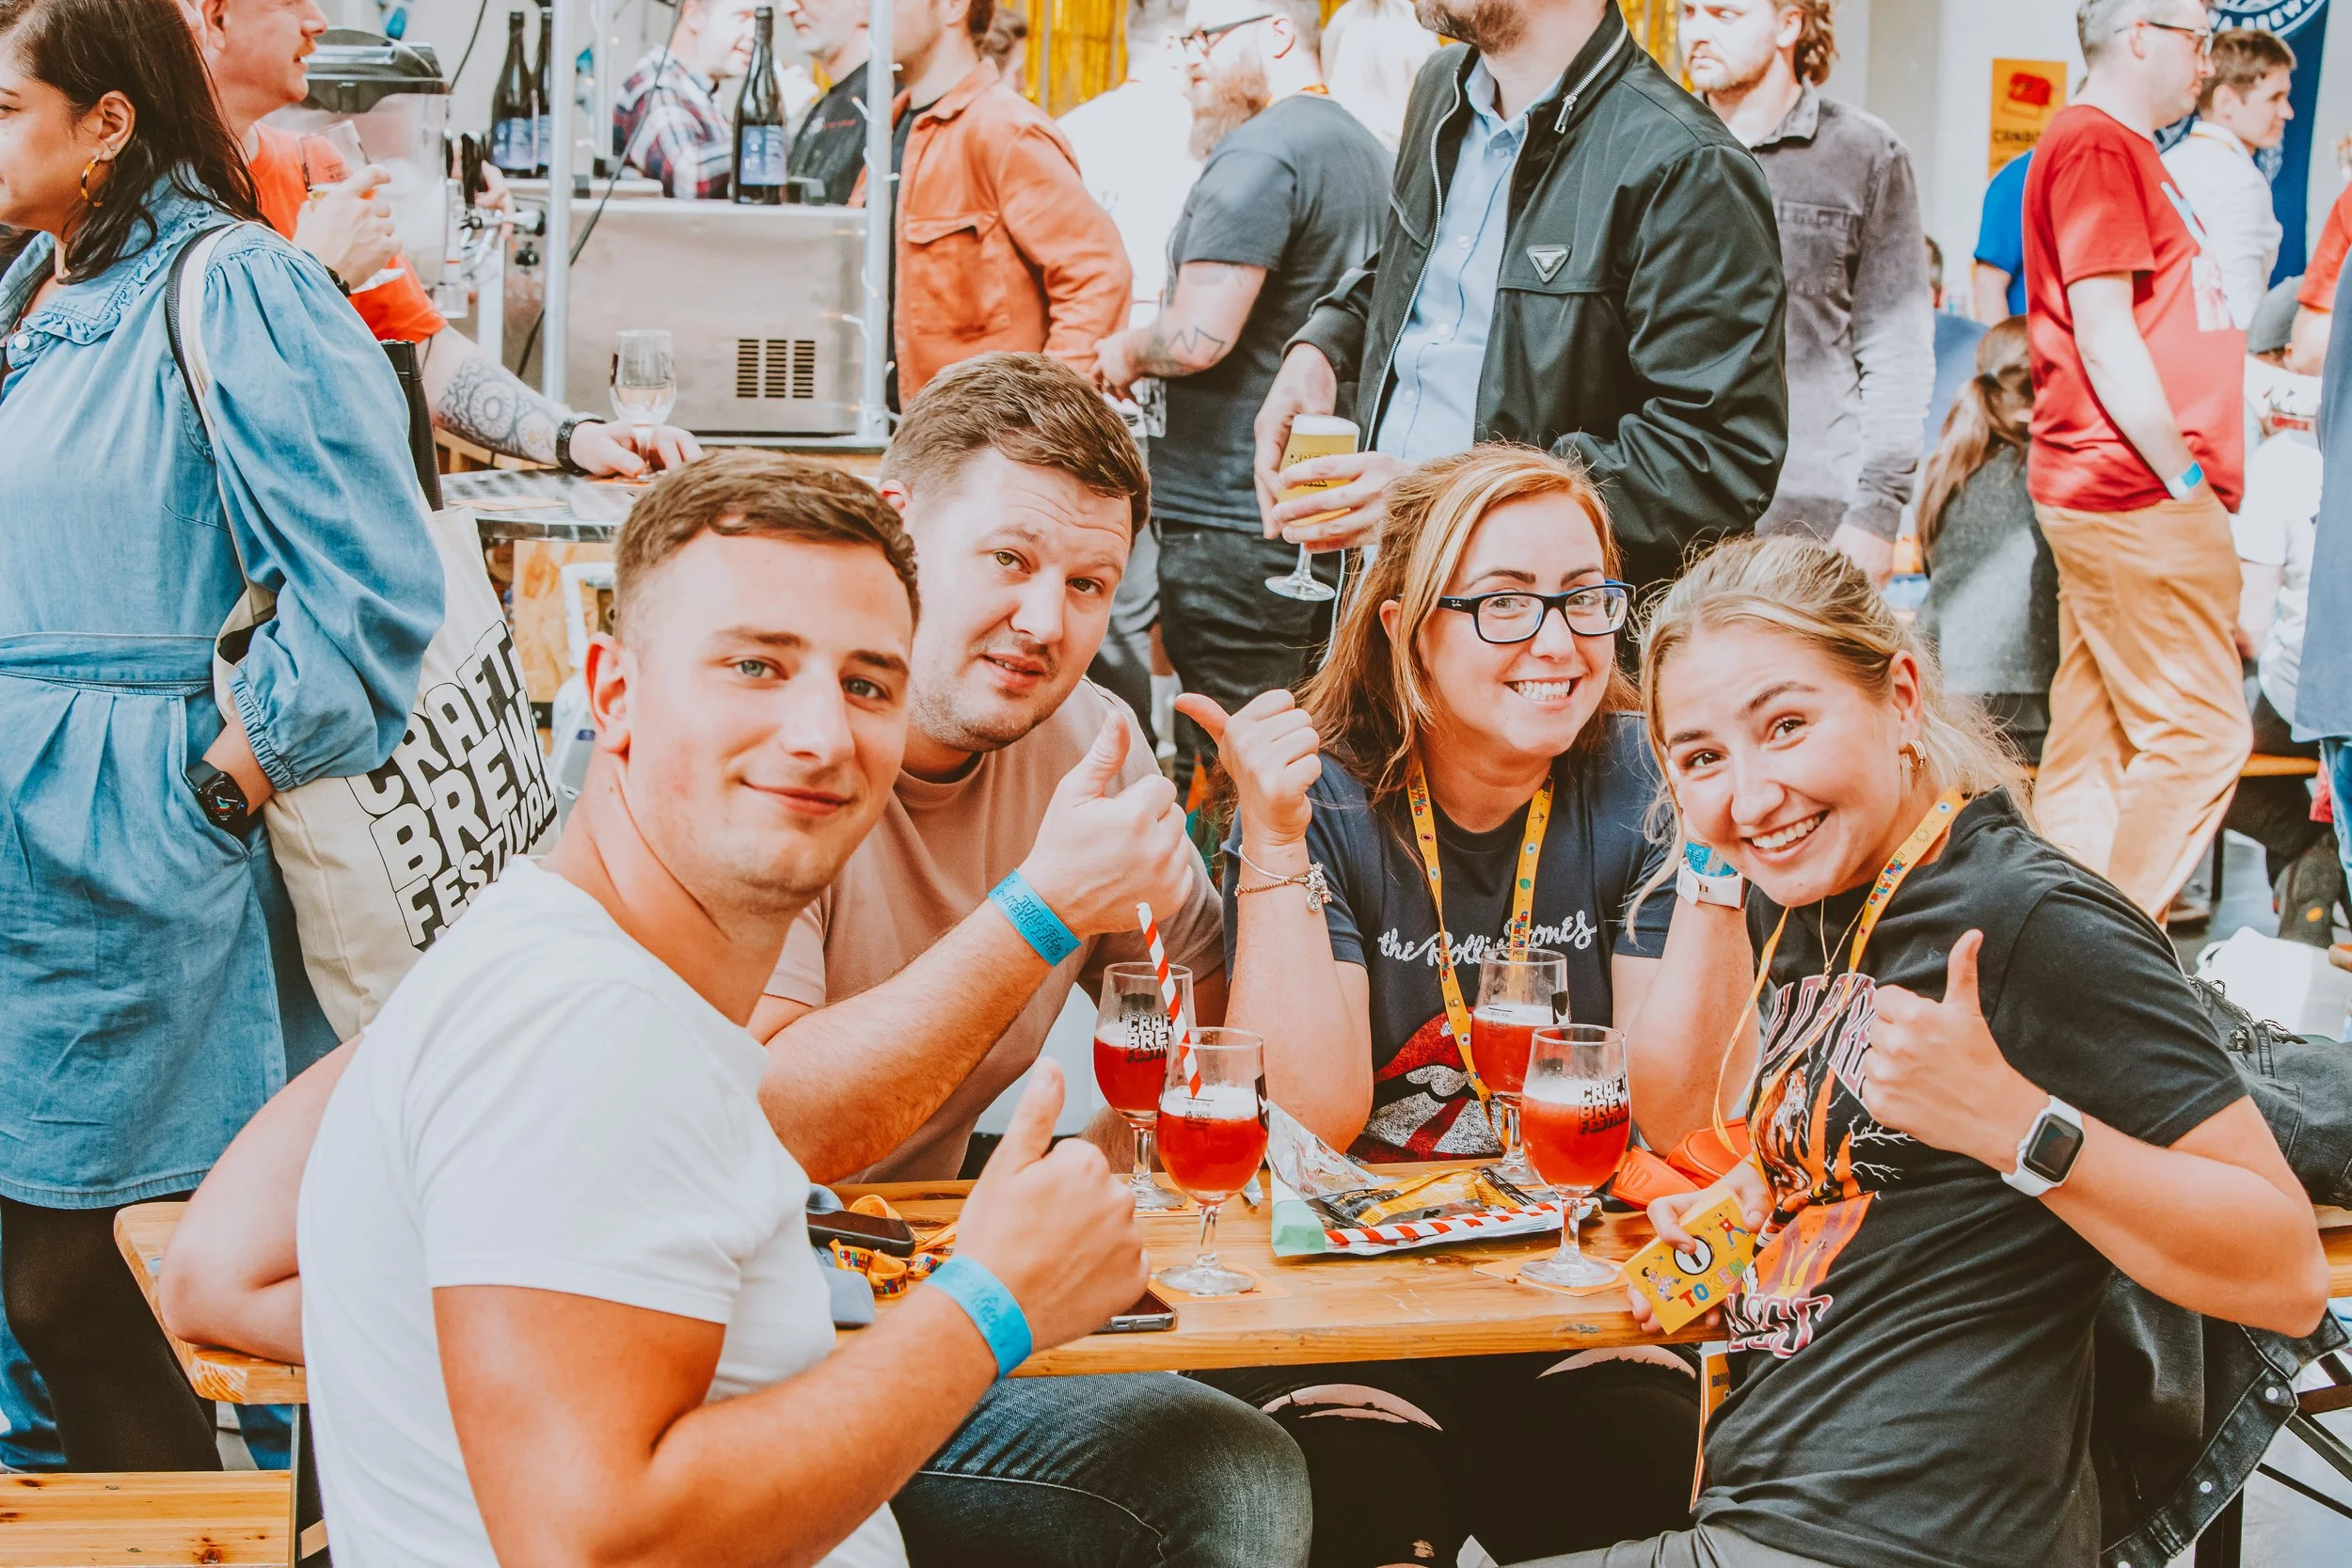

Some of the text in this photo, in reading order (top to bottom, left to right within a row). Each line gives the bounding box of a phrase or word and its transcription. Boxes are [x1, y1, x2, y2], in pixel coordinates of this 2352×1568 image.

[370, 688, 548, 893] BREW
[395, 771, 558, 952] FESTIVAL
[1377, 927, 1414, 962] the
[1127, 1012, 1172, 1034] CRAF
[1678, 1258, 1746, 1308] TOKEN
